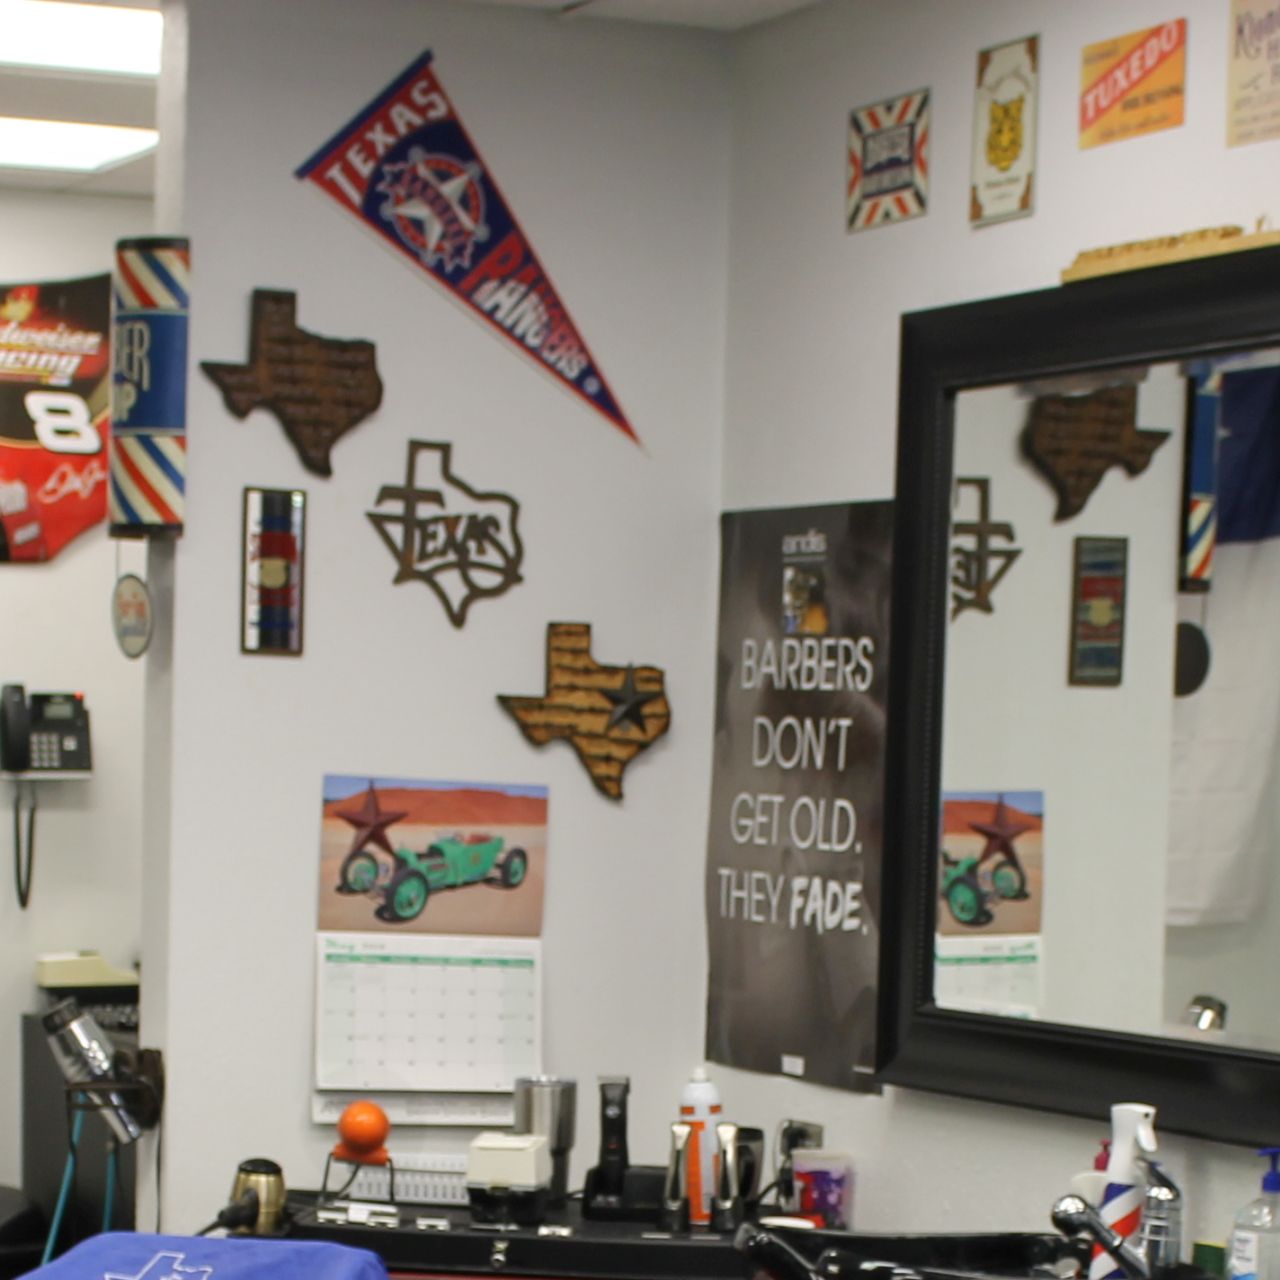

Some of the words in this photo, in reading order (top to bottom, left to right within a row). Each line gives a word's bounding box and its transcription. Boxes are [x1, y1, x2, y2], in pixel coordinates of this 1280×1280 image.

[1081, 20, 1180, 121] TUXEDO
[323, 79, 451, 206] TEXAS
[24, 391, 103, 454] 8
[375, 486, 508, 584] TEXAS
[740, 636, 875, 693] BARBERS
[752, 716, 852, 772] DON'T
[730, 793, 784, 847] GET
[789, 796, 863, 855] OLD.
[718, 866, 787, 924] THEY
[789, 874, 869, 936] FADE.
